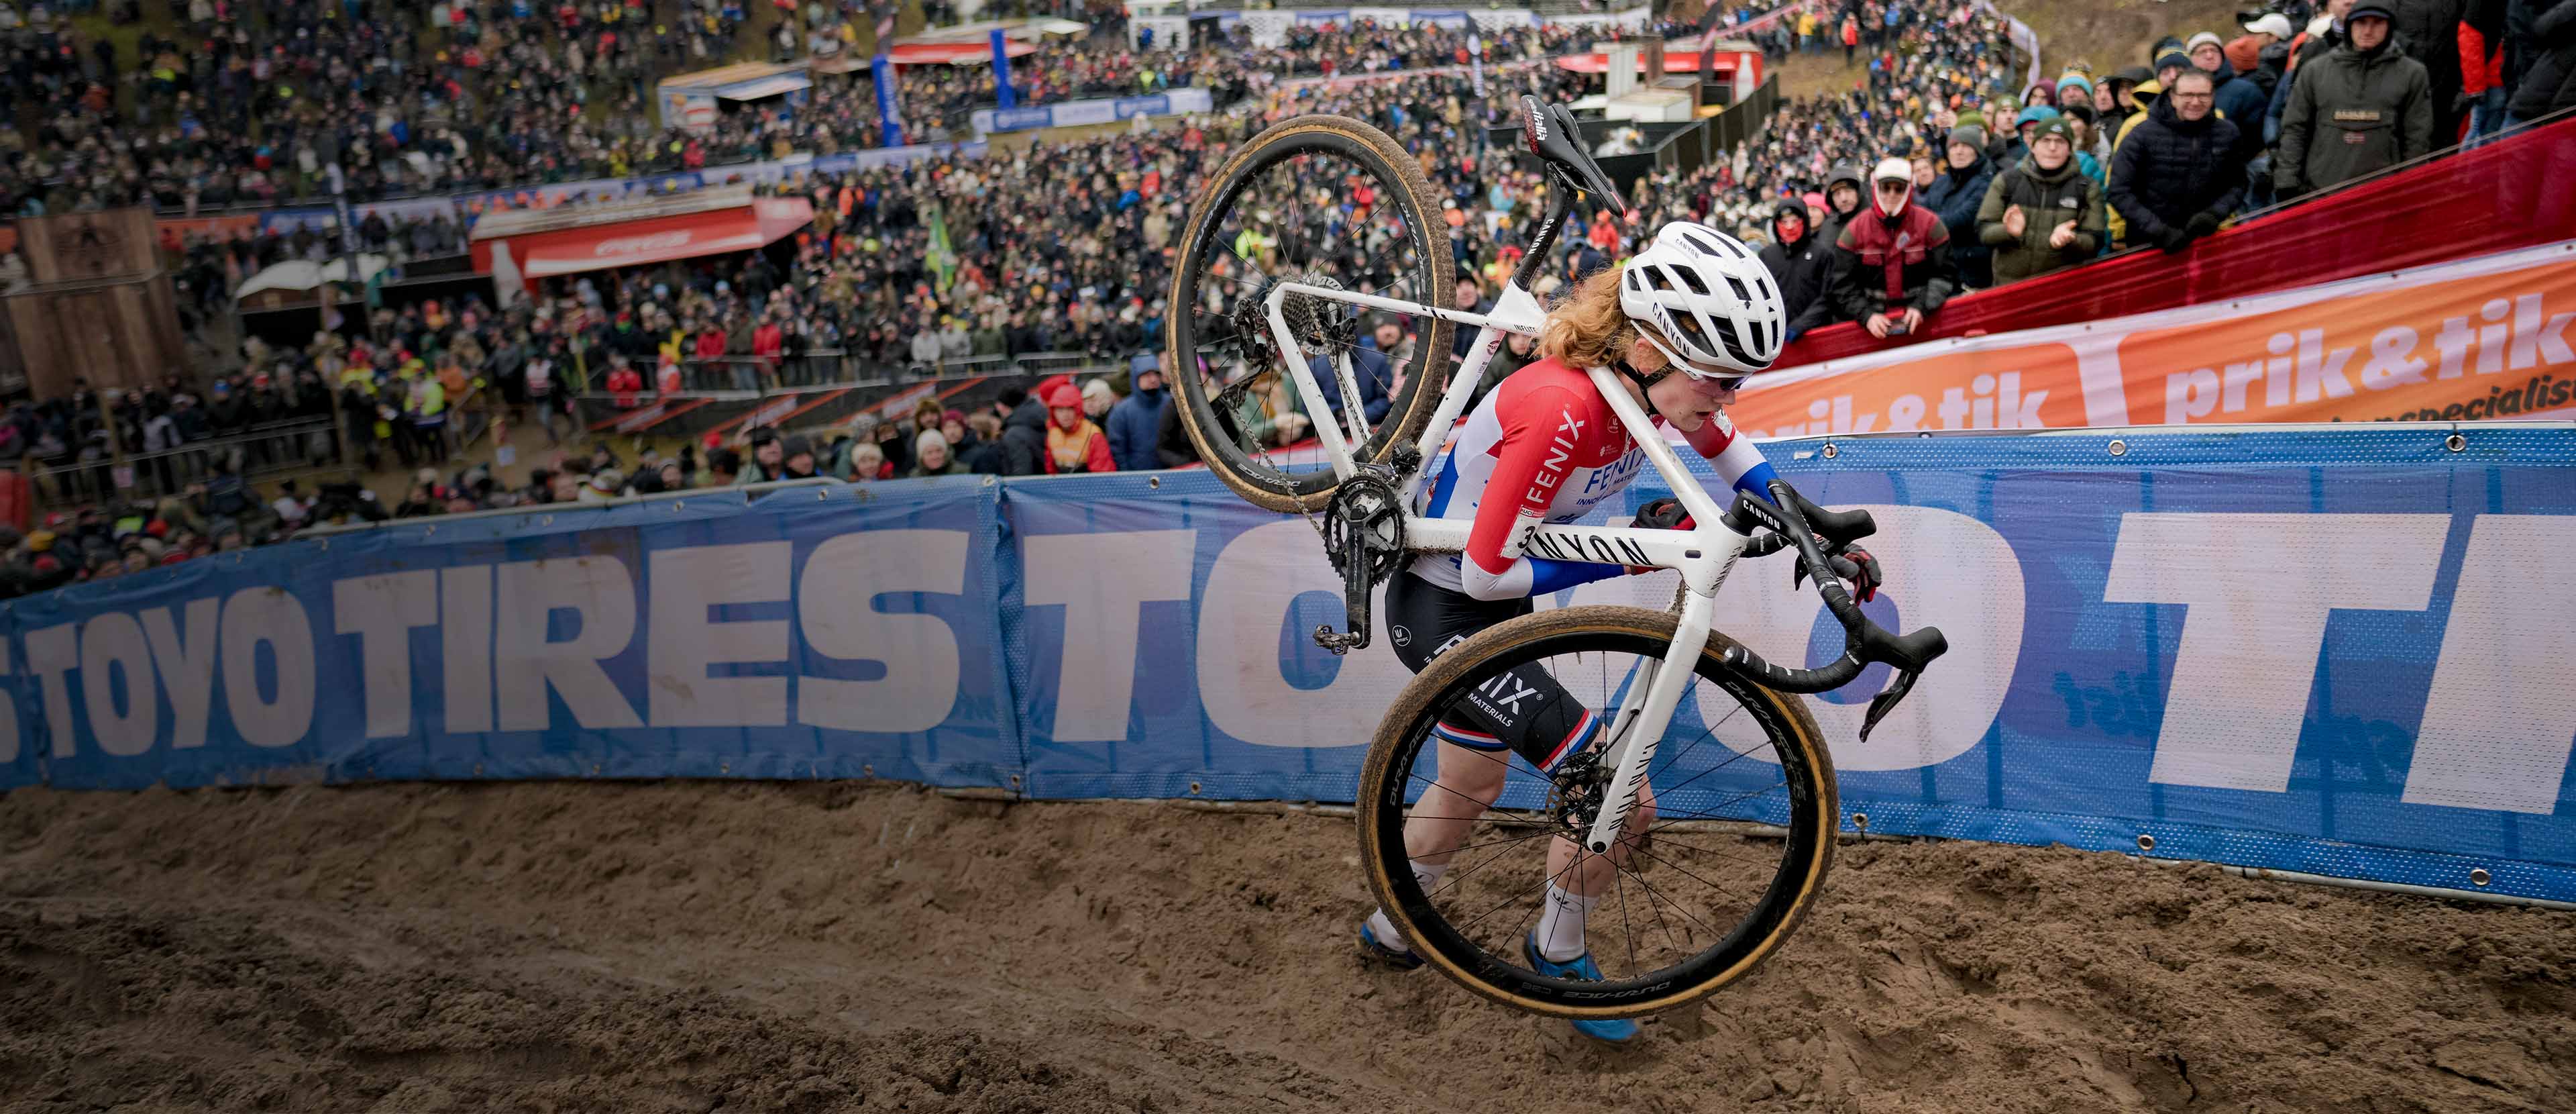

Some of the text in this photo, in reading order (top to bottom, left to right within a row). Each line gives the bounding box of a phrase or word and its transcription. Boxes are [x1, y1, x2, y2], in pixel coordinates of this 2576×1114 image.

[1533, 111, 1548, 140] italia
[1528, 218, 1555, 254] CANYON
[1675, 238, 1699, 259] CANYON
[1514, 323, 1538, 334] INFLITE
[1652, 302, 1690, 356] CANYON
[2165, 293, 2576, 424] prik&tik
[1748, 371, 2049, 436] ik&tik
[1526, 409, 1585, 503] FENIX
[1743, 499, 1780, 530] CANYON
[1517, 525, 1536, 549] 3
[1525, 532, 1654, 566] NYON
[25, 587, 315, 758] TOYO
[333, 529, 969, 739] TIRES
[1024, 505, 2576, 814] TOO TI
[1468, 693, 1513, 727] MATERIALS
